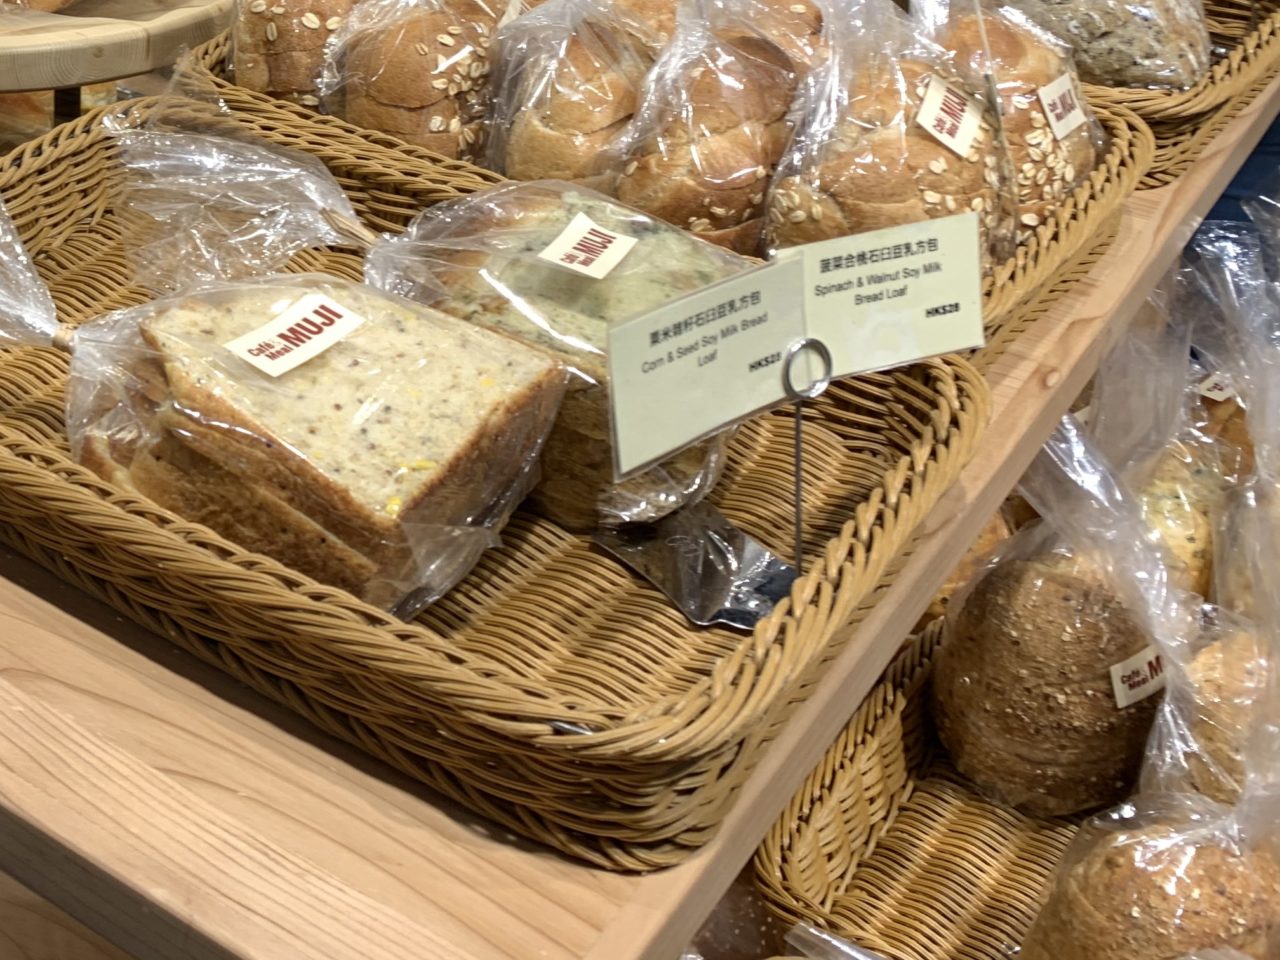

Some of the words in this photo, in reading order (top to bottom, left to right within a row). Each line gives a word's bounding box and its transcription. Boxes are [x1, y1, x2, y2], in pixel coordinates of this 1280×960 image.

[940, 86, 969, 125] MUJI
[572, 227, 617, 258] MUJI
[814, 279, 854, 298] Spinach
[856, 276, 865, 288] &
[866, 270, 901, 286] Walnut
[902, 267, 921, 280] Soy
[923, 261, 943, 275] Milk
[854, 290, 884, 306] Bread
[886, 284, 908, 299] Loaf
[276, 303, 344, 348] MUJI
[247, 340, 276, 357] Café
[264, 343, 294, 361] Meal
[641, 356, 665, 374] Corn
[666, 351, 675, 364] &
[676, 339, 700, 359] Seed
[701, 334, 719, 348] Soy
[720, 323, 739, 339] Milk
[740, 311, 769, 332] Bread
[697, 348, 719, 368] Loaf
[1120, 667, 1140, 685] Café
[1128, 674, 1150, 691] Meal
